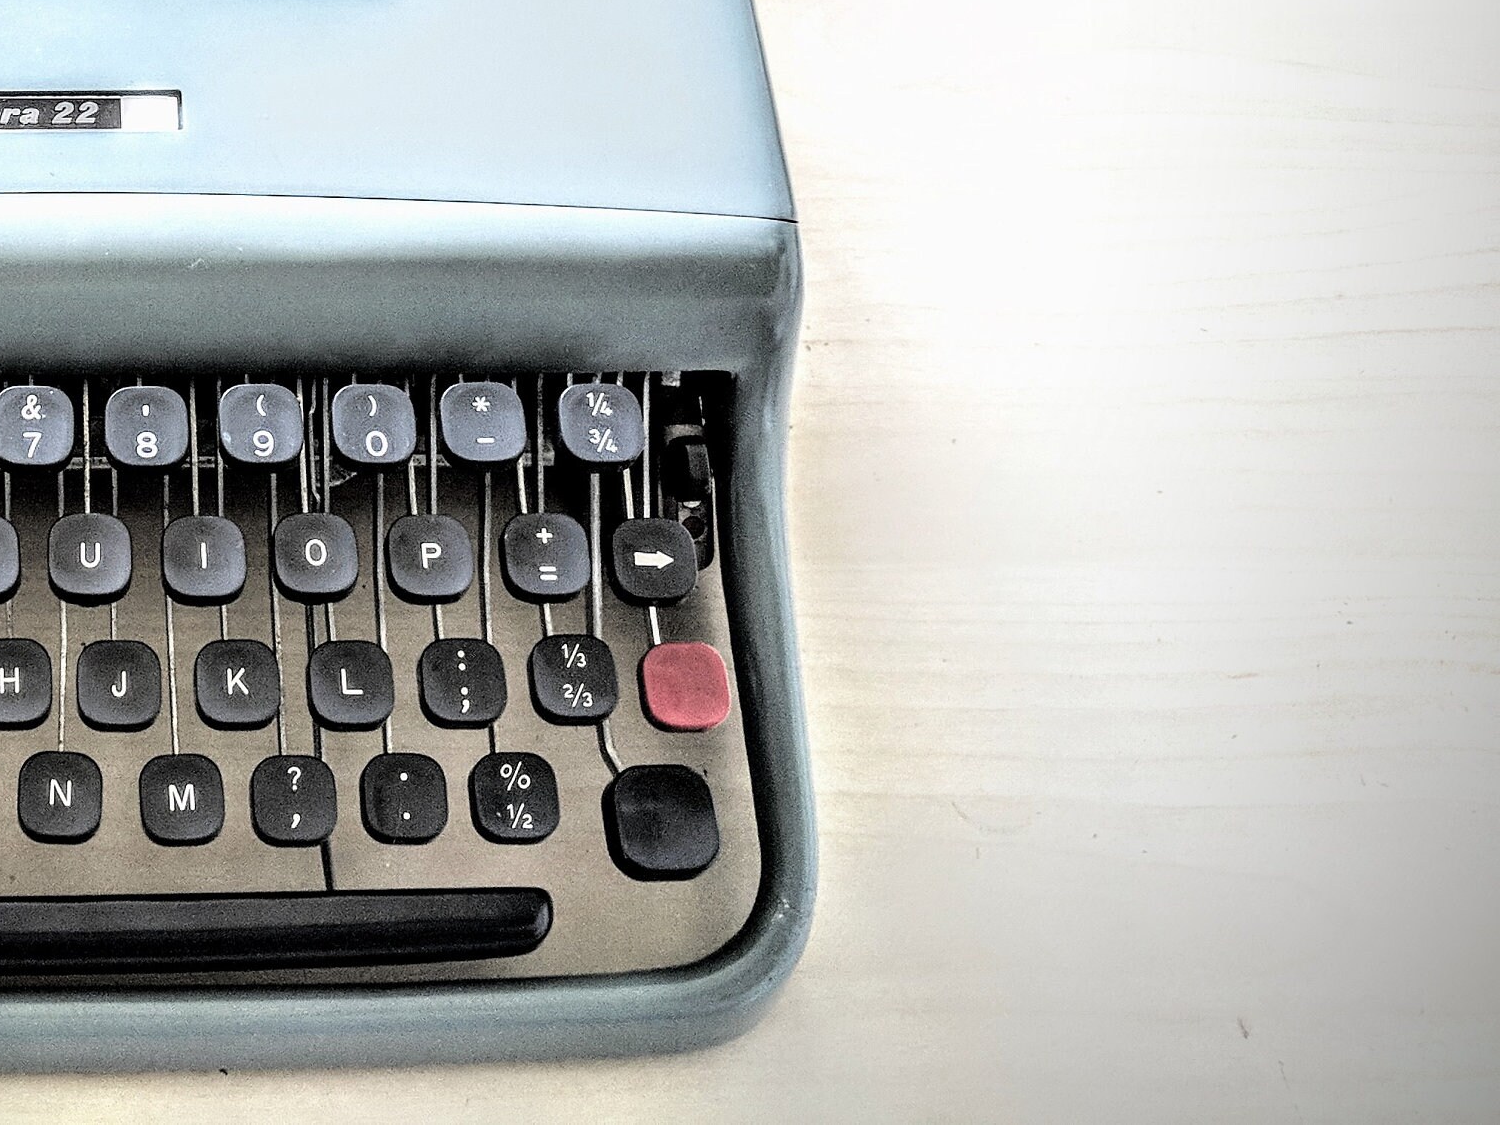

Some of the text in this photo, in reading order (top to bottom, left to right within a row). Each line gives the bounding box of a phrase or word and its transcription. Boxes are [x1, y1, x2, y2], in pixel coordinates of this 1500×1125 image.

[52, 101, 99, 124] 22
[20, 394, 42, 421] &
[22, 431, 43, 459] 7
[136, 431, 159, 459] 8
[252, 430, 275, 457] 9
[80, 542, 101, 569] U
[421, 542, 442, 569] P
[0, 667, 20, 694] H
[111, 670, 127, 698] J
[226, 667, 249, 695] K
[340, 668, 364, 695] L
[49, 778, 72, 807] N
[287, 766, 302, 793] ?
[168, 783, 196, 812] M
